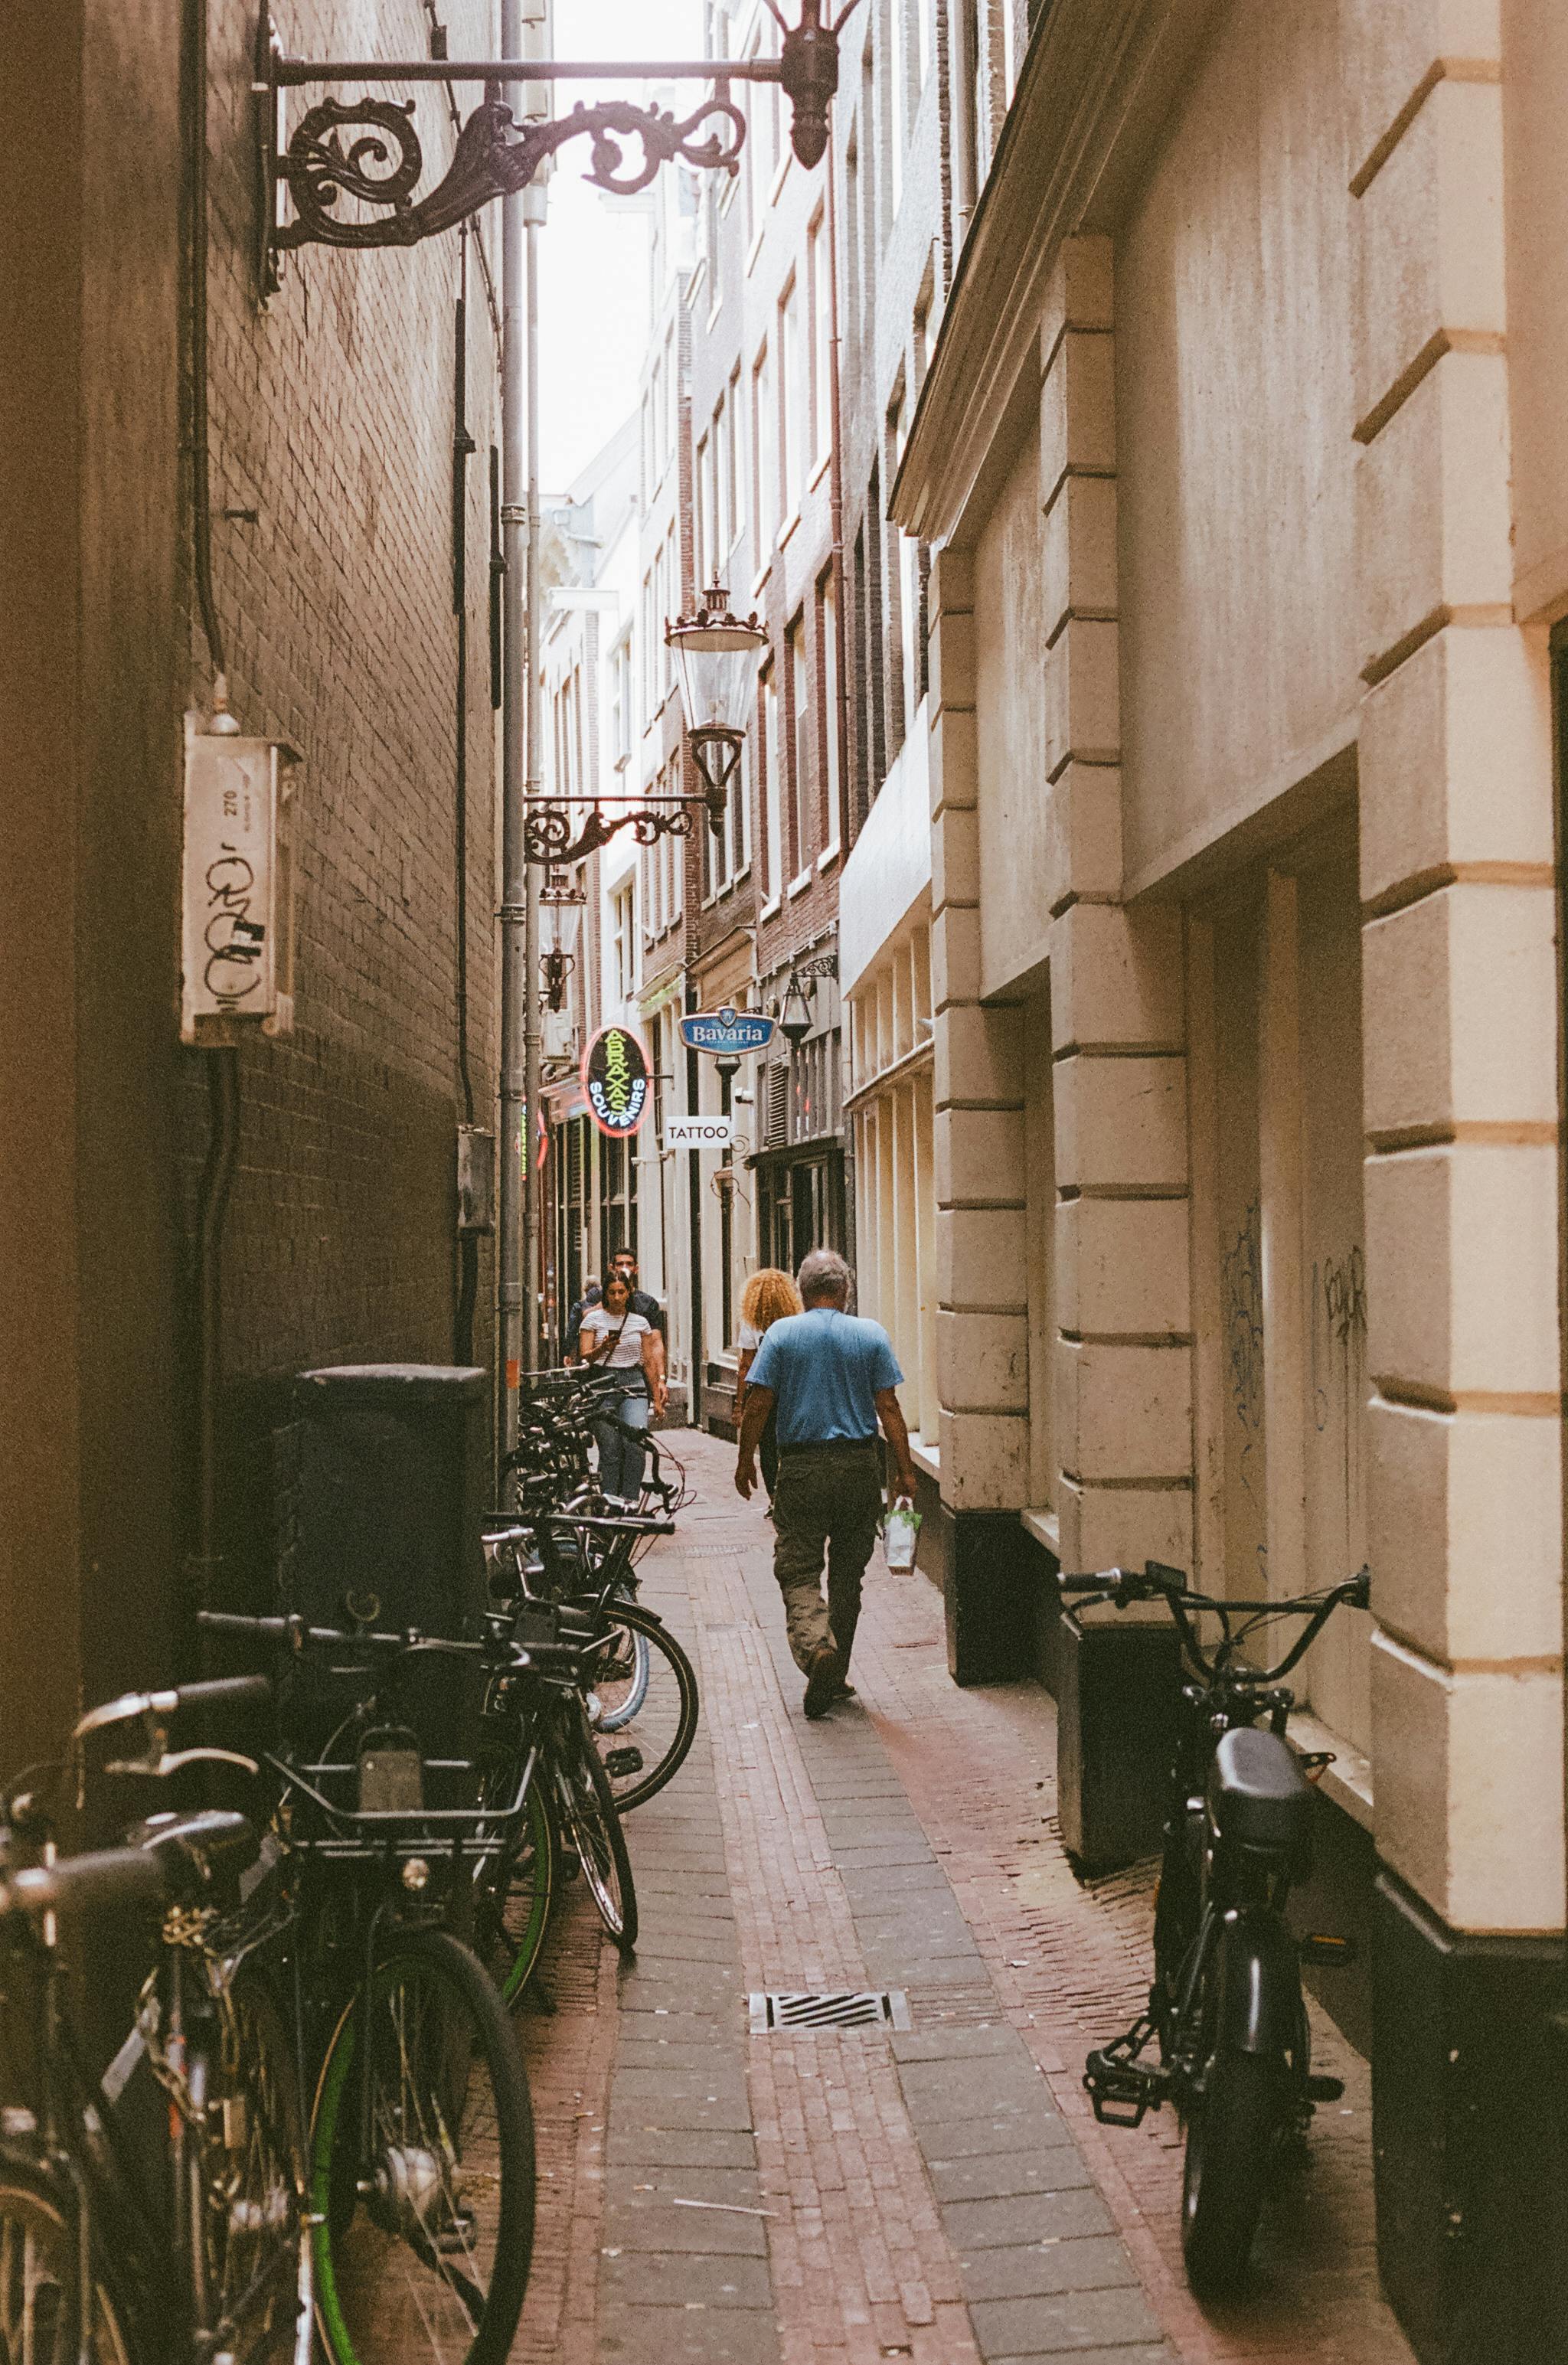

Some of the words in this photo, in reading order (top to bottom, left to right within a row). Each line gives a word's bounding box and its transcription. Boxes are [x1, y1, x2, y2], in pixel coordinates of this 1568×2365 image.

[223, 790, 237, 817] 270
[692, 1024, 763, 1042] Bavaria
[605, 1029, 630, 1116] ABRAXAS
[590, 1078, 645, 1128] SOUVENIRS
[668, 1126, 728, 1139] TATTOO
